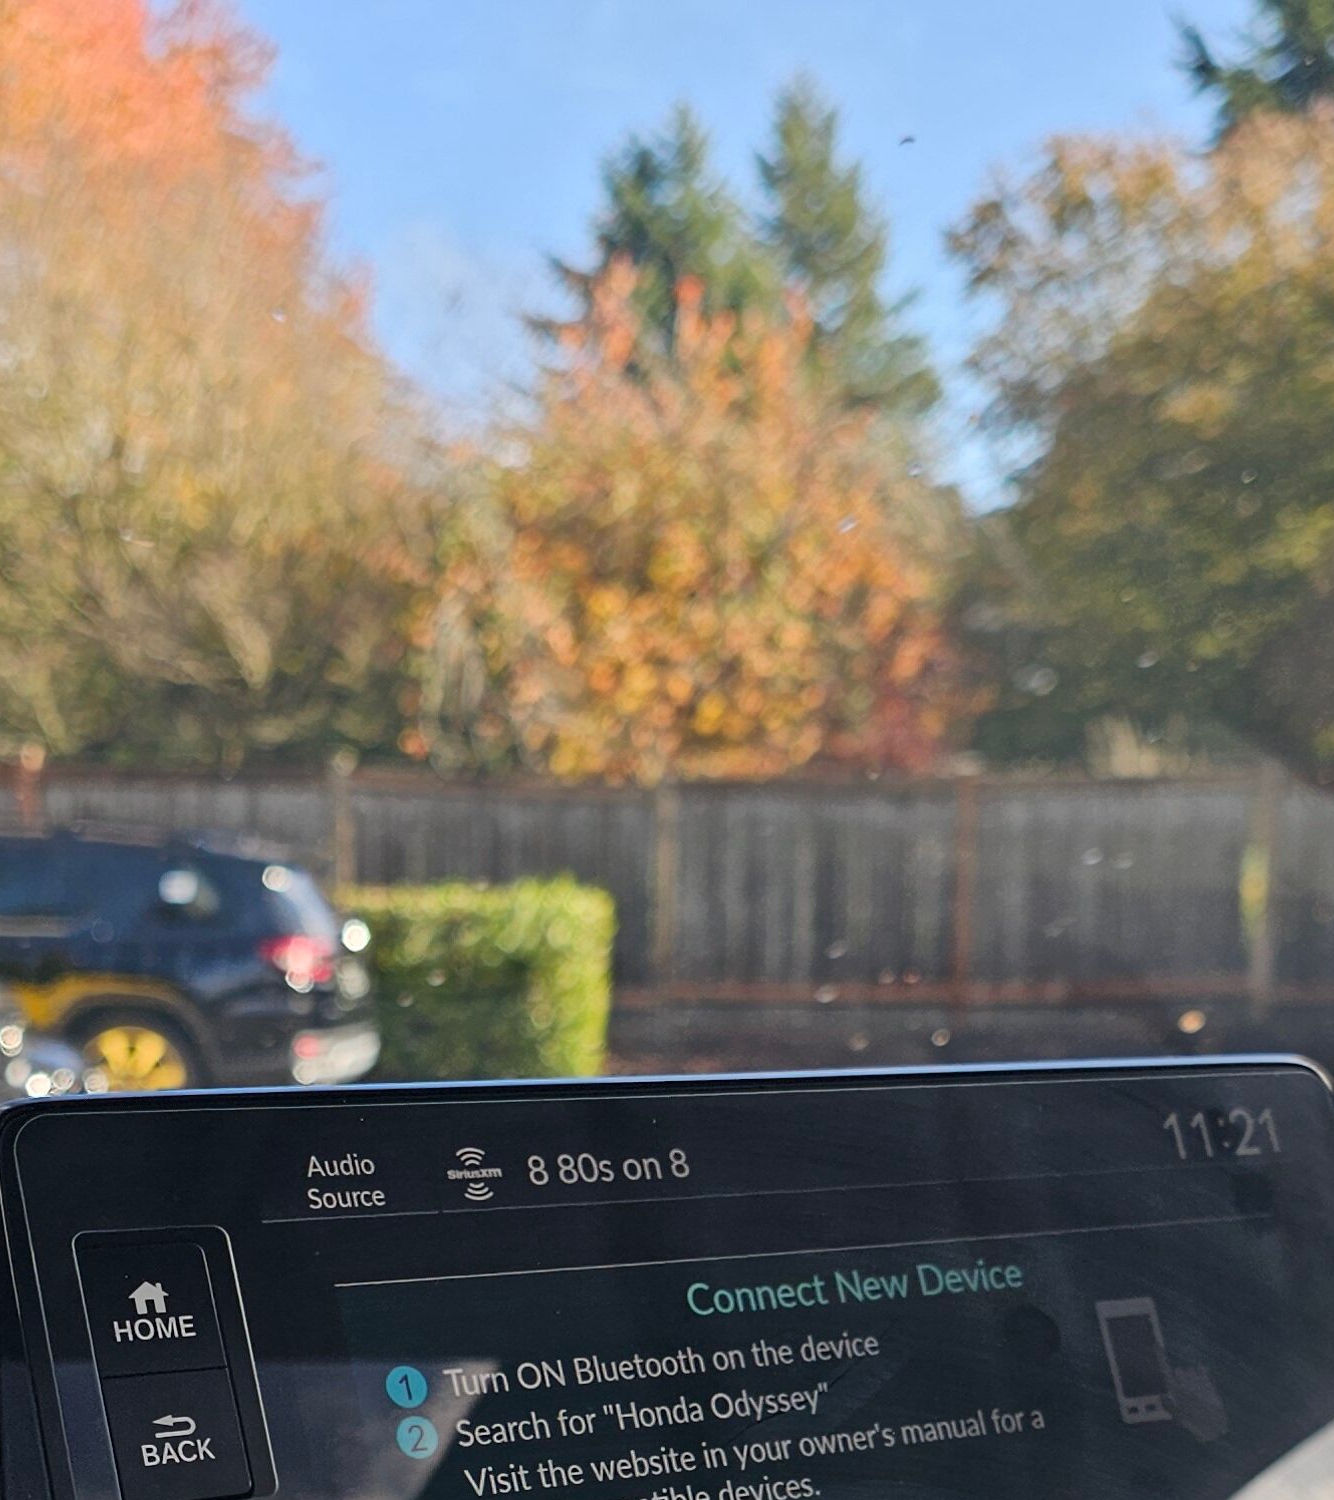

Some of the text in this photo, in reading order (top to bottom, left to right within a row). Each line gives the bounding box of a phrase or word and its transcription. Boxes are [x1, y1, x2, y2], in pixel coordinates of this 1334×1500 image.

[1162, 1107, 1282, 1160] 11:21
[306, 1153, 376, 1178] Audio
[527, 1147, 690, 1186] 8 80s on 8
[306, 1187, 387, 1210] Source
[686, 1258, 1024, 1317] Connect New Device
[112, 1314, 197, 1343] HOME
[442, 1367, 510, 1397] Turn
[516, 1359, 567, 1390] ON
[573, 1347, 706, 1385] Bluetooth
[712, 1348, 746, 1372] on
[750, 1339, 795, 1368] the
[799, 1330, 880, 1363] device
[407, 1382, 829, 1453] 2 Search for "Honda Odyssey"
[140, 1437, 217, 1467] BACK
[464, 1407, 1046, 1497] Visit the website in your owner's manual for a
